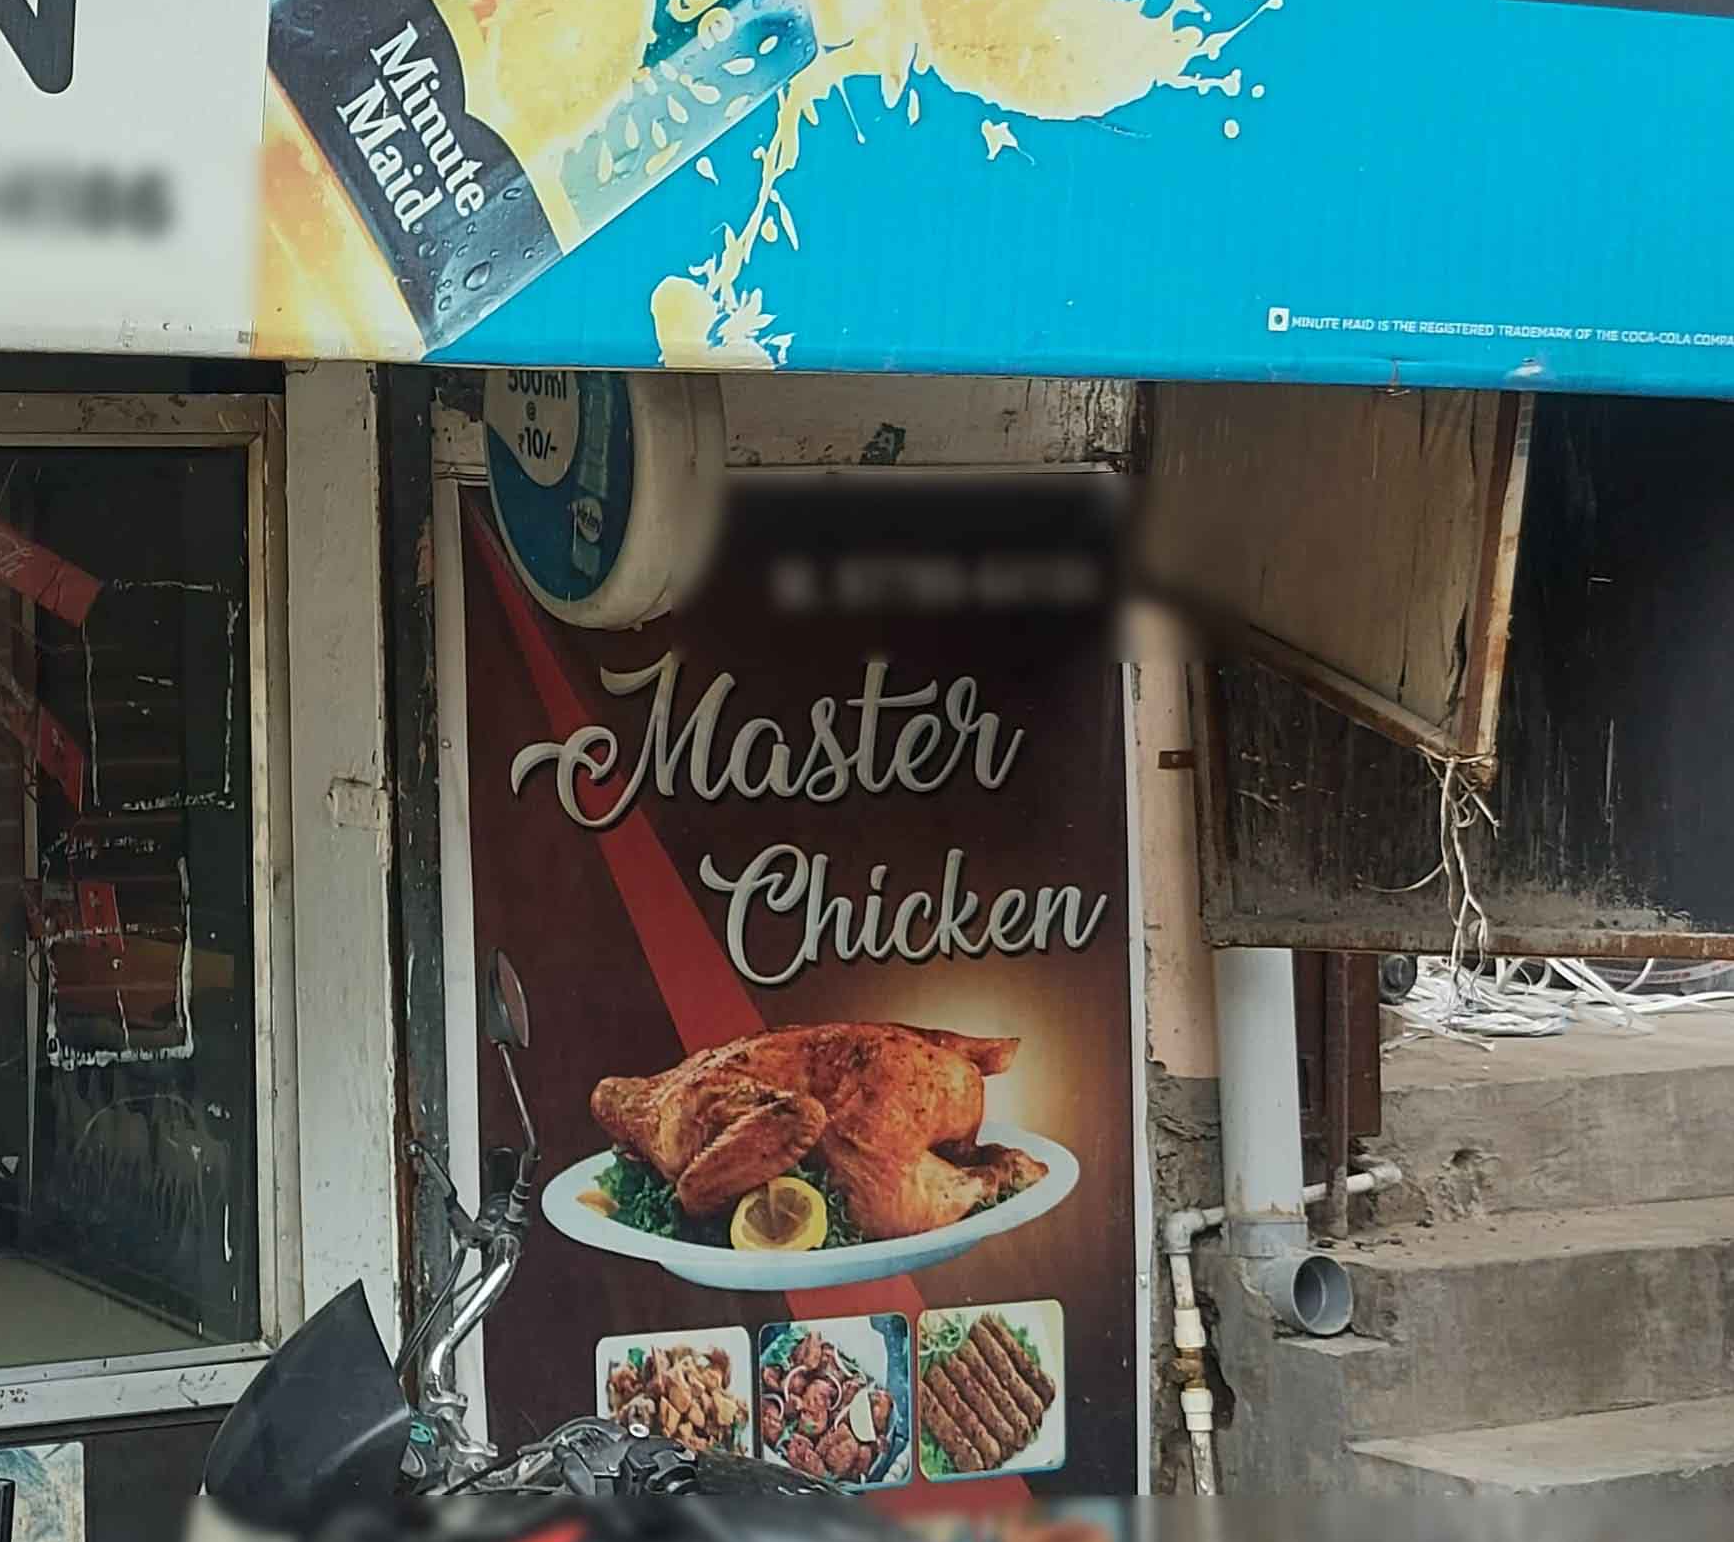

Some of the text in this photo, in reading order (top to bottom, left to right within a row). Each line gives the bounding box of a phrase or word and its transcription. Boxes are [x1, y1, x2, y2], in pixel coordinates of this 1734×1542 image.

[336, 79, 444, 233] Maid
[369, 20, 486, 218] Minute
[1291, 316, 1339, 330] MINUTE
[1342, 317, 1374, 331] MAID
[1377, 319, 1390, 332] IS
[1392, 319, 1416, 333] THE
[1418, 321, 1495, 336] REGISTERED
[1497, 324, 1572, 340] TRADEMARK
[1575, 328, 1593, 340] OF
[1596, 329, 1619, 342] THE
[1621, 330, 1691, 346] COCA-COLA
[511, 649, 1023, 830] Master
[700, 842, 1108, 987] Chicken
